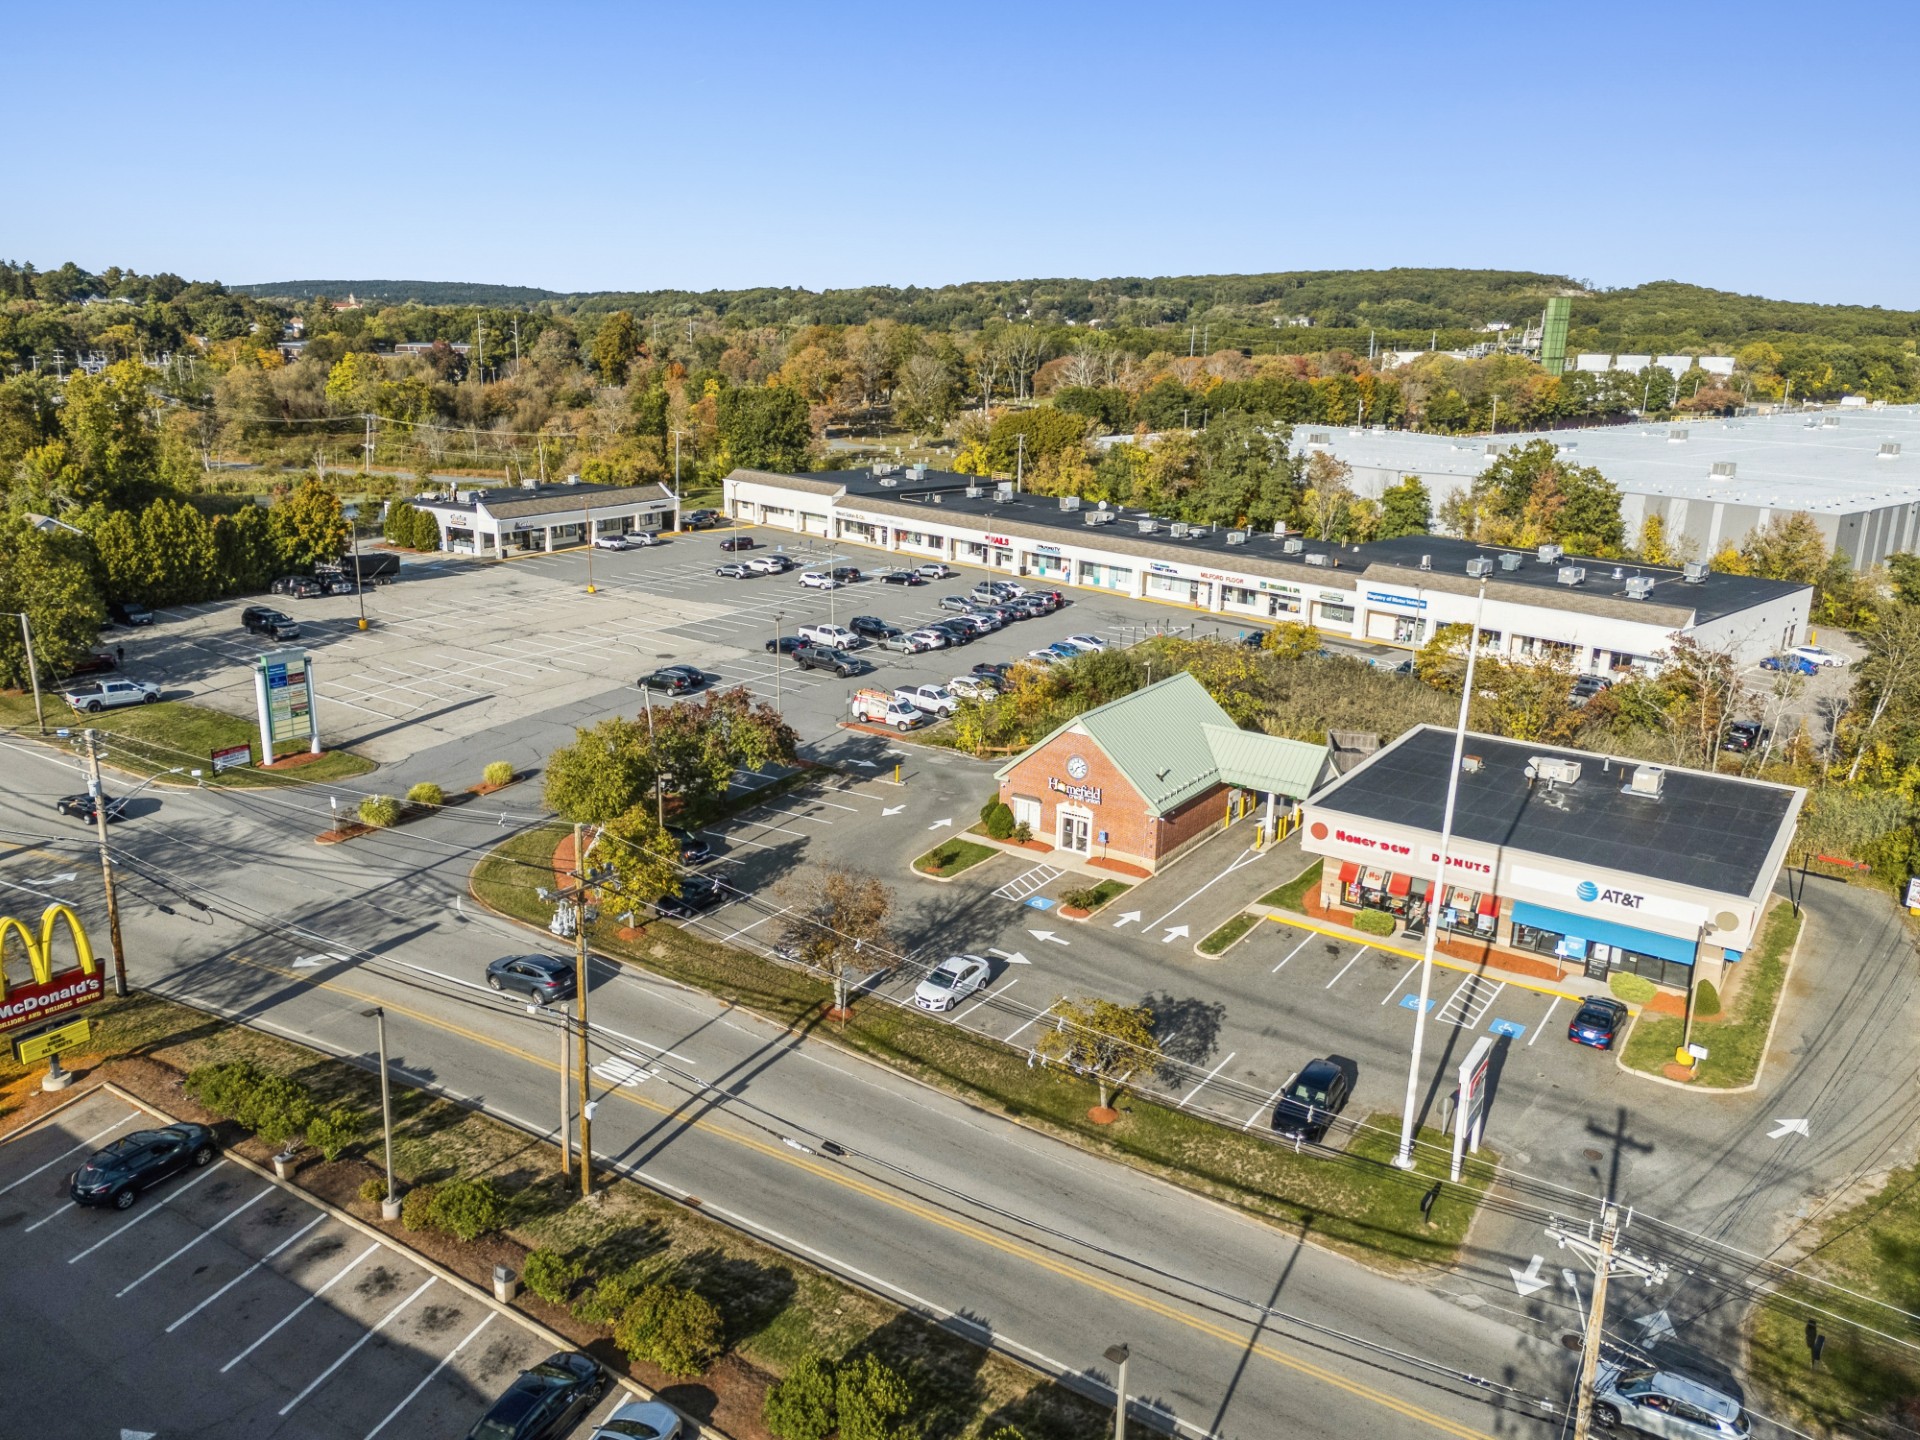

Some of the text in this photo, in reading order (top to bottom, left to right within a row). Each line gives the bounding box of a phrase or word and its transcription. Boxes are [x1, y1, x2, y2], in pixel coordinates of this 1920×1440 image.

[1200, 572, 1224, 582] MILFORD
[1432, 853, 1490, 873] DONUTS
[1600, 889, 1644, 909] AT&T
[0, 980, 100, 1018] McDonald's
[76, 992, 100, 1004] SERVED
